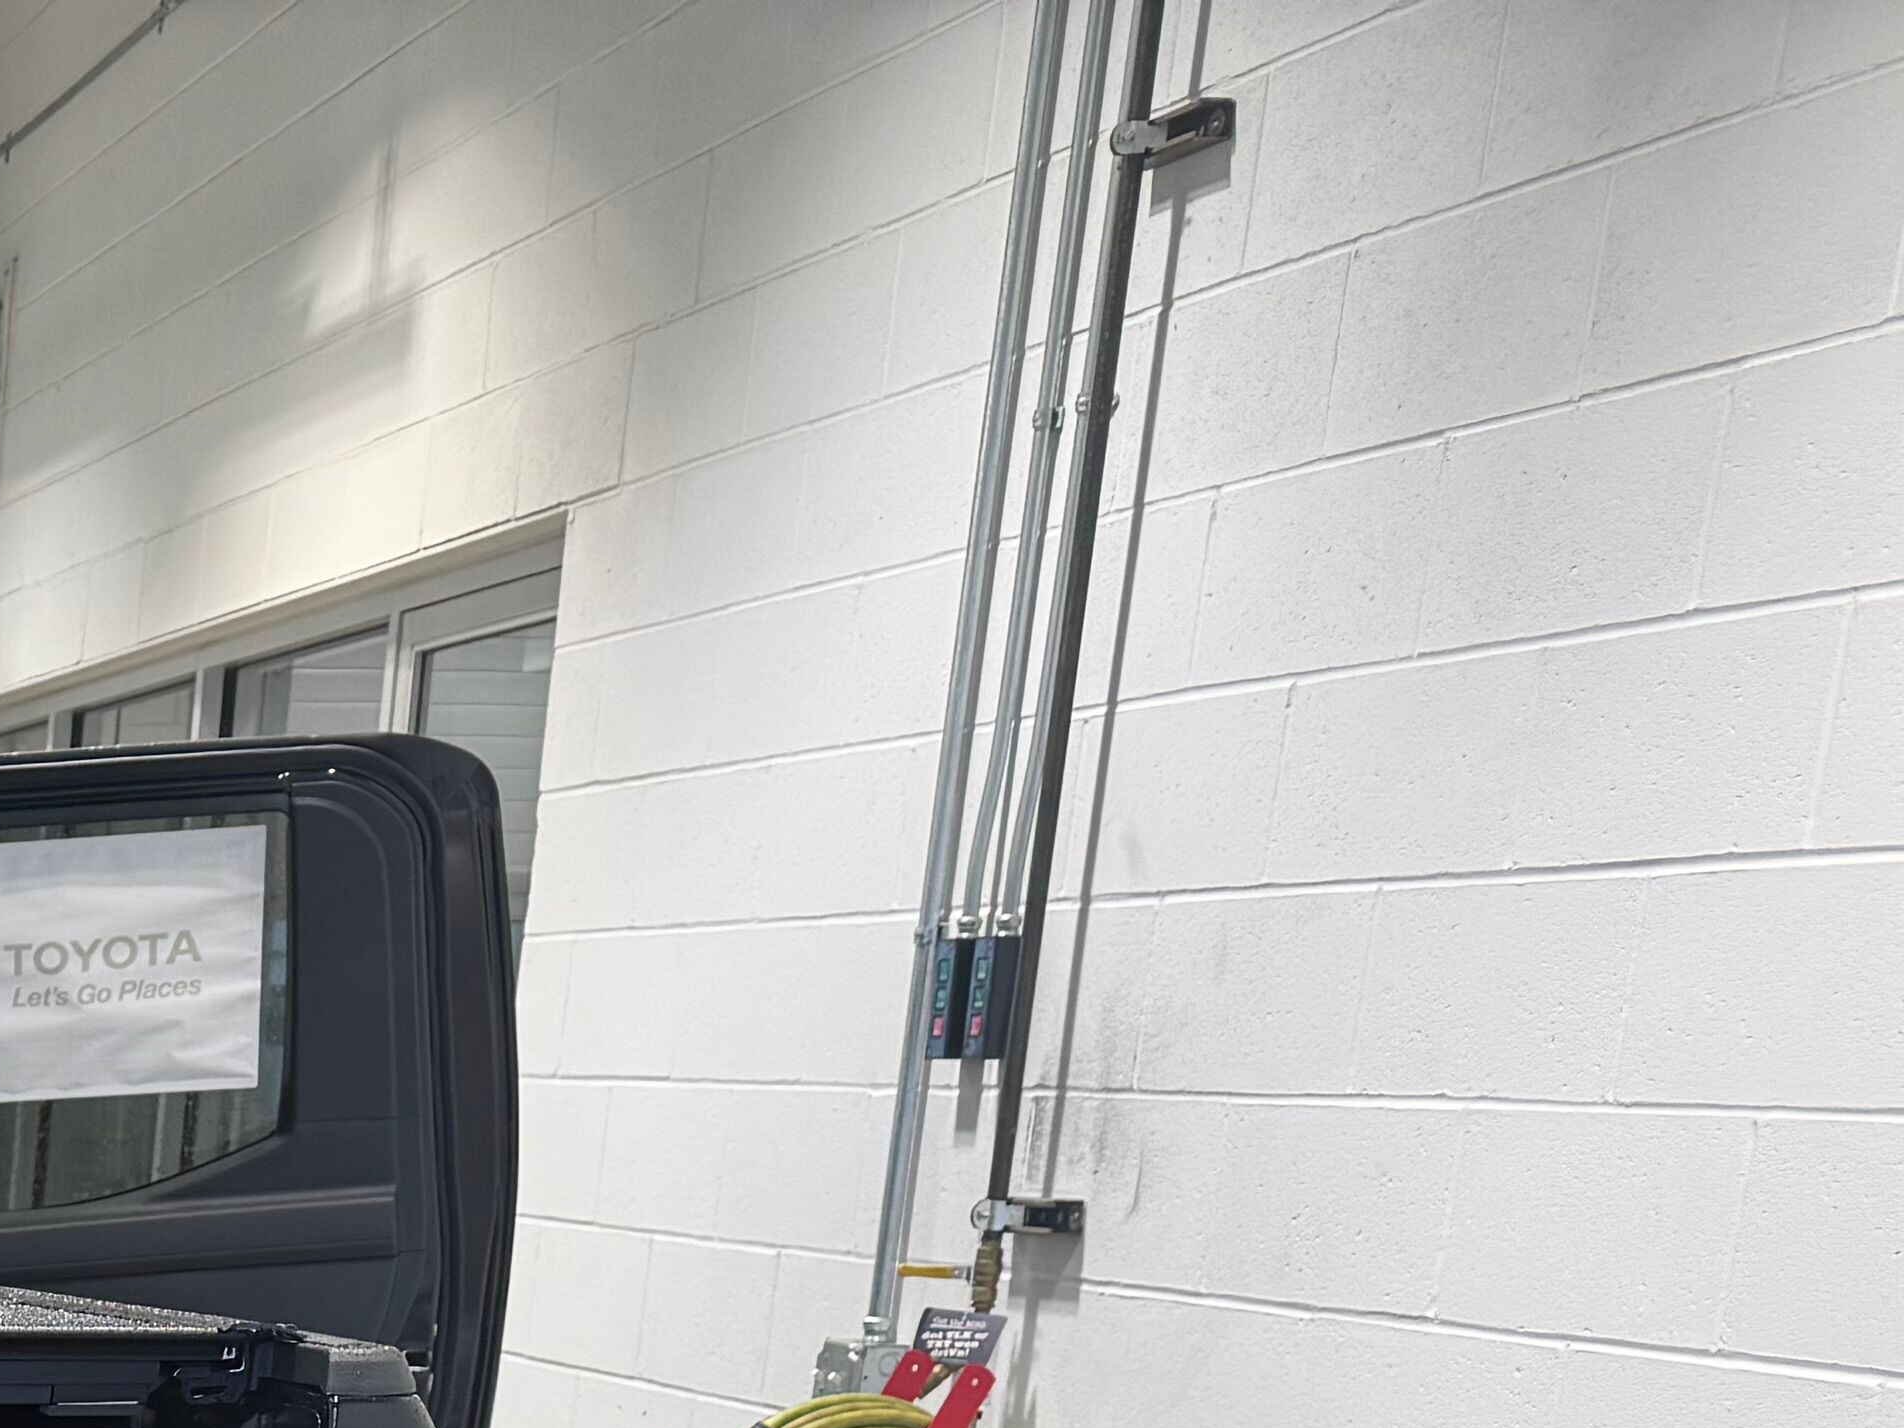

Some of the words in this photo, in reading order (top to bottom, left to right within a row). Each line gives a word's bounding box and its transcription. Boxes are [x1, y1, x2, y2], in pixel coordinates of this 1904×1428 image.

[3, 929, 202, 977] TOYOTA
[12, 986, 71, 1009] Let's
[78, 983, 112, 1004] Go
[120, 977, 202, 999] Places
